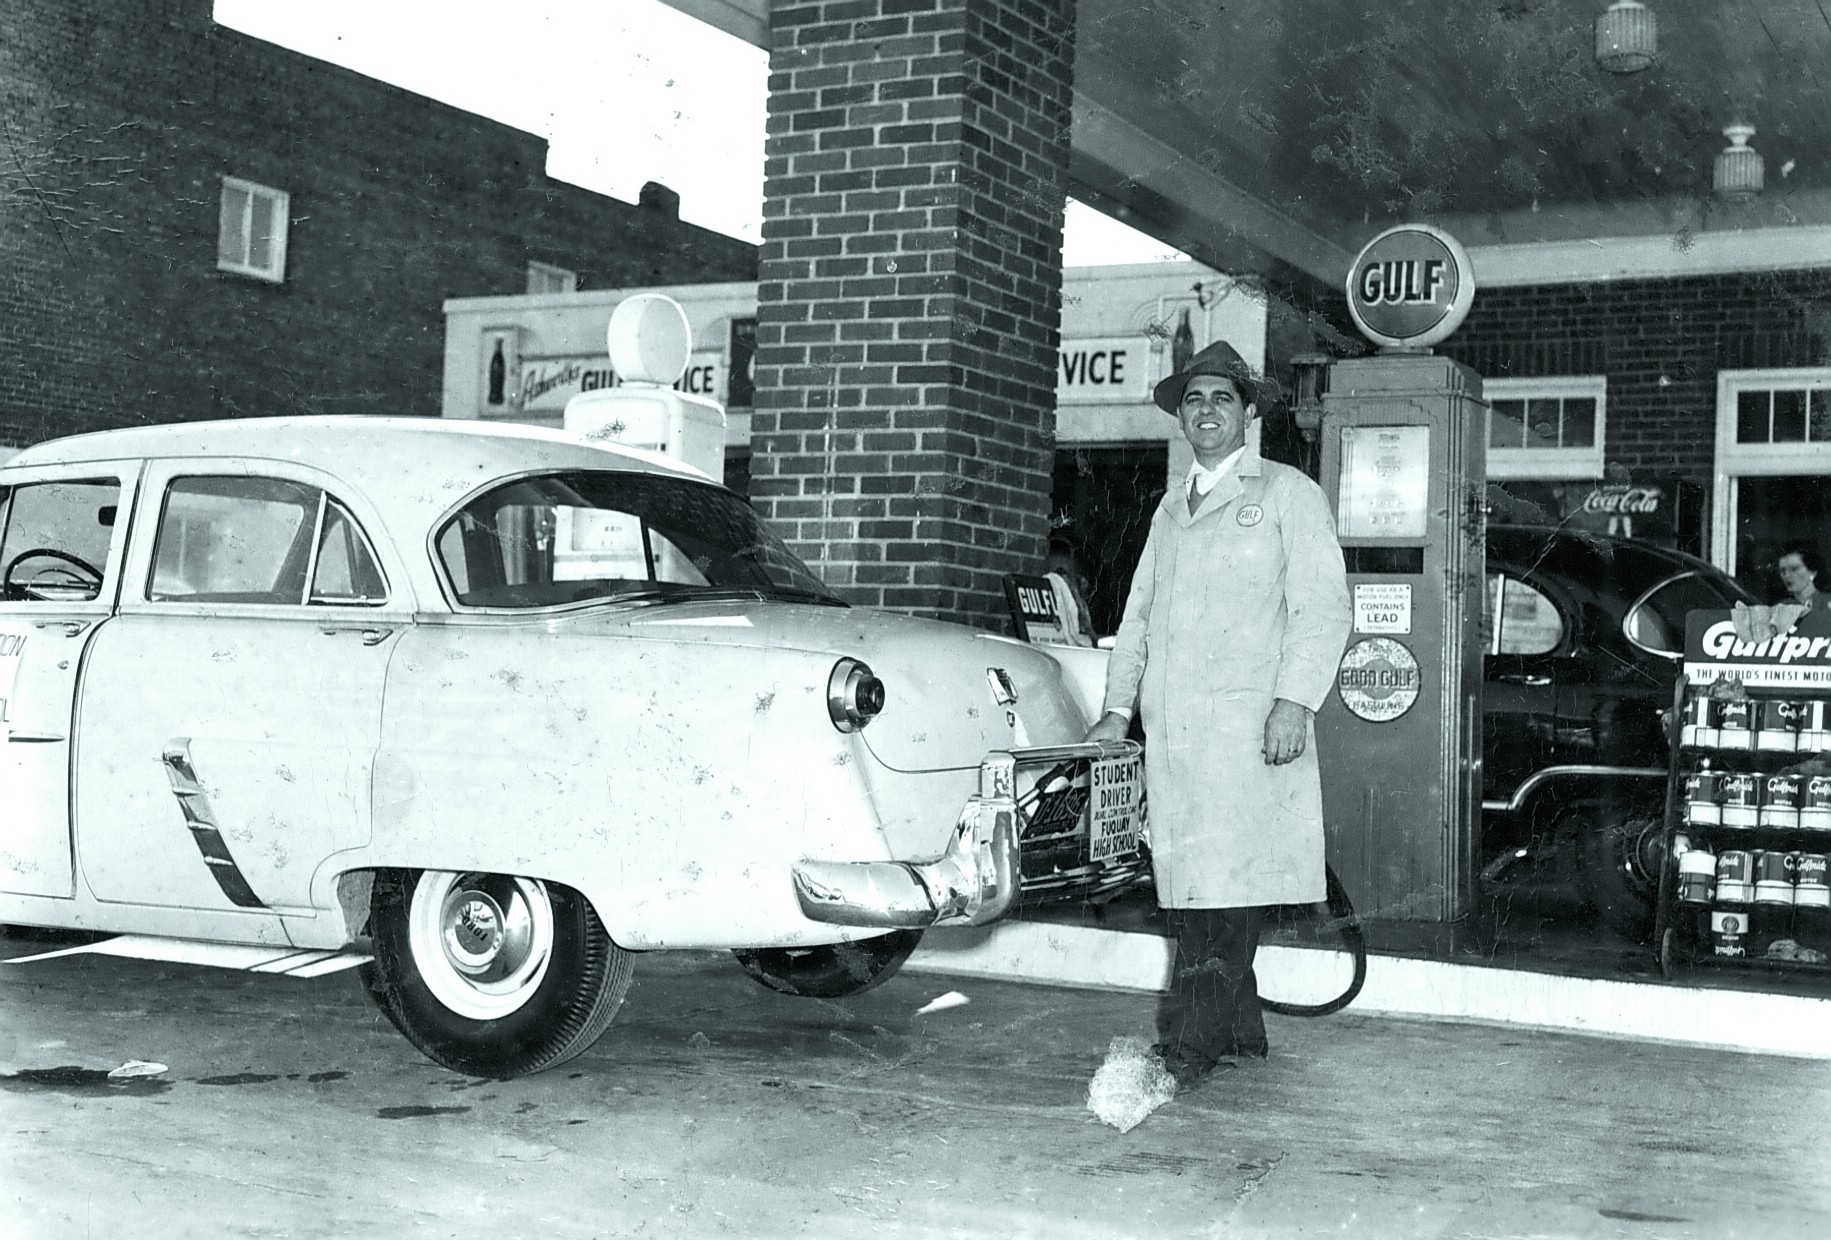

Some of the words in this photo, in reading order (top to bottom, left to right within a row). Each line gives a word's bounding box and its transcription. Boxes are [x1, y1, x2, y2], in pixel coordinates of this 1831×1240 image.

[1360, 260, 1446, 306] GULF
[582, 370, 624, 392] GUL
[1239, 510, 1259, 519] GULF
[1360, 603, 1405, 611] CONTAINS
[1367, 613, 1398, 623] LEAD
[1341, 669, 1378, 688] GOOD
[1381, 669, 1415, 688] GULF
[1697, 669, 1713, 679] THE
[1718, 669, 1759, 680] WORLD'S
[1764, 670, 1798, 681] FINEST
[1094, 761, 1139, 786] STUDENT
[1101, 786, 1131, 808] DRIVER
[1101, 816, 1131, 837] FUQUAY
[1093, 837, 1111, 858] HIGH
[1112, 832, 1136, 854] SCHOOL
[461, 915, 489, 941] FORD
